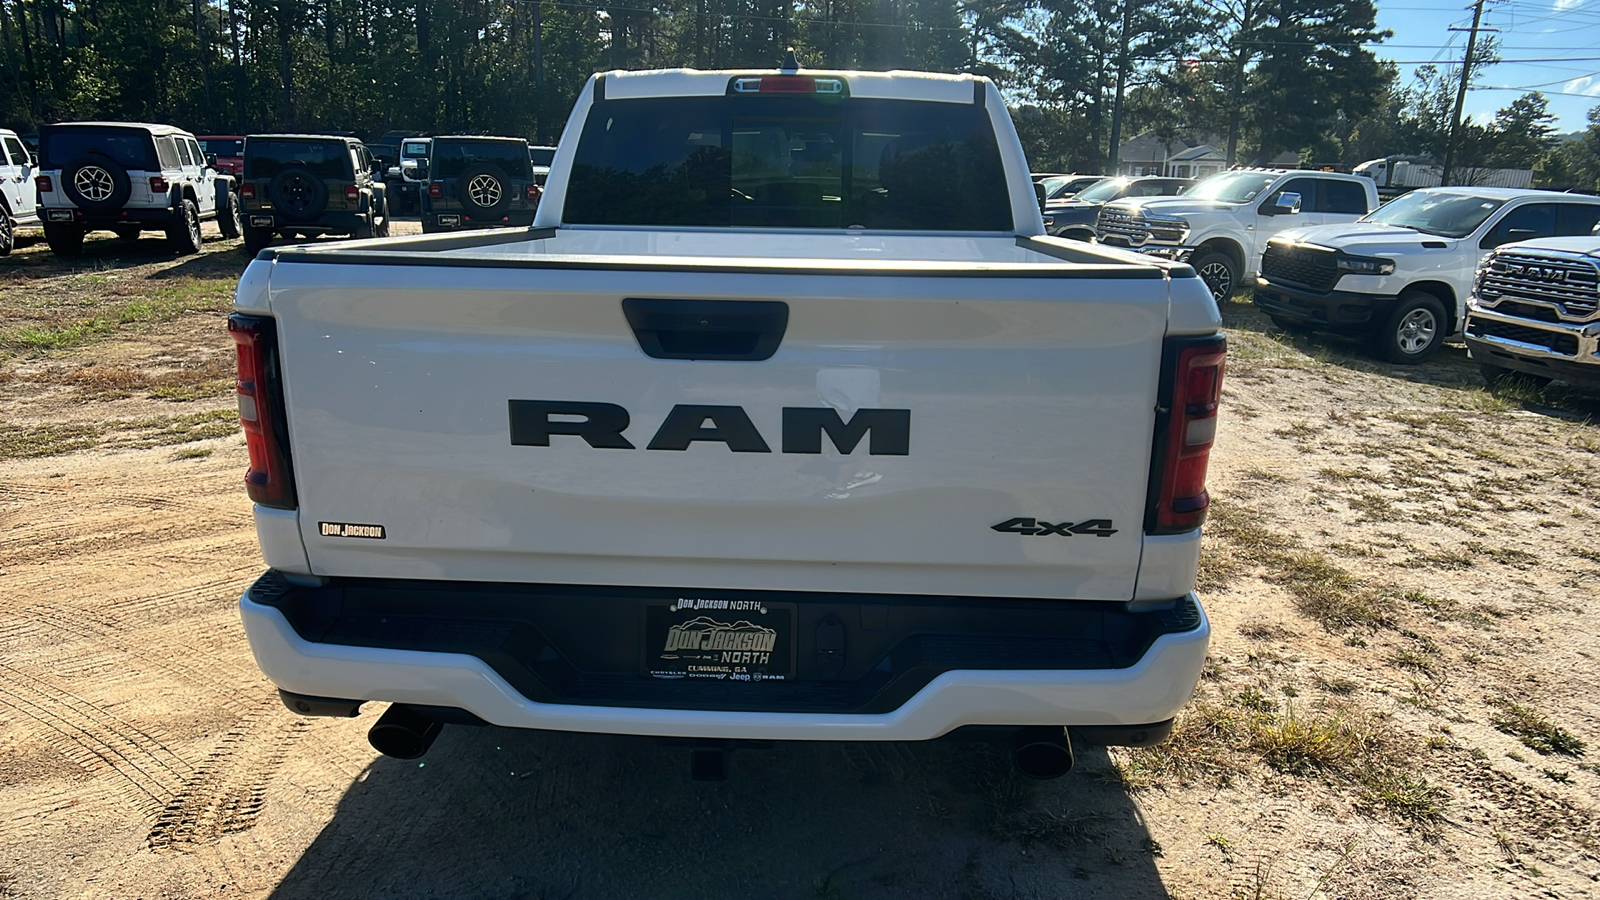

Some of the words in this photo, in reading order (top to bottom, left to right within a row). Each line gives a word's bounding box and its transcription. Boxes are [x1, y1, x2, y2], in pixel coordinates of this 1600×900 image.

[1506, 264, 1564, 280] RAM
[508, 399, 911, 456] RAM
[322, 523, 340, 535] DON
[341, 524, 381, 537] JACKSON
[990, 517, 1119, 537] 4x4
[677, 598, 694, 610] DON
[694, 598, 729, 610] JACKSON
[730, 600, 761, 611] NORTH
[664, 629, 702, 651] DON
[700, 629, 777, 652] JACKSON
[721, 651, 770, 664] NORTH
[729, 672, 751, 682] Jeep
